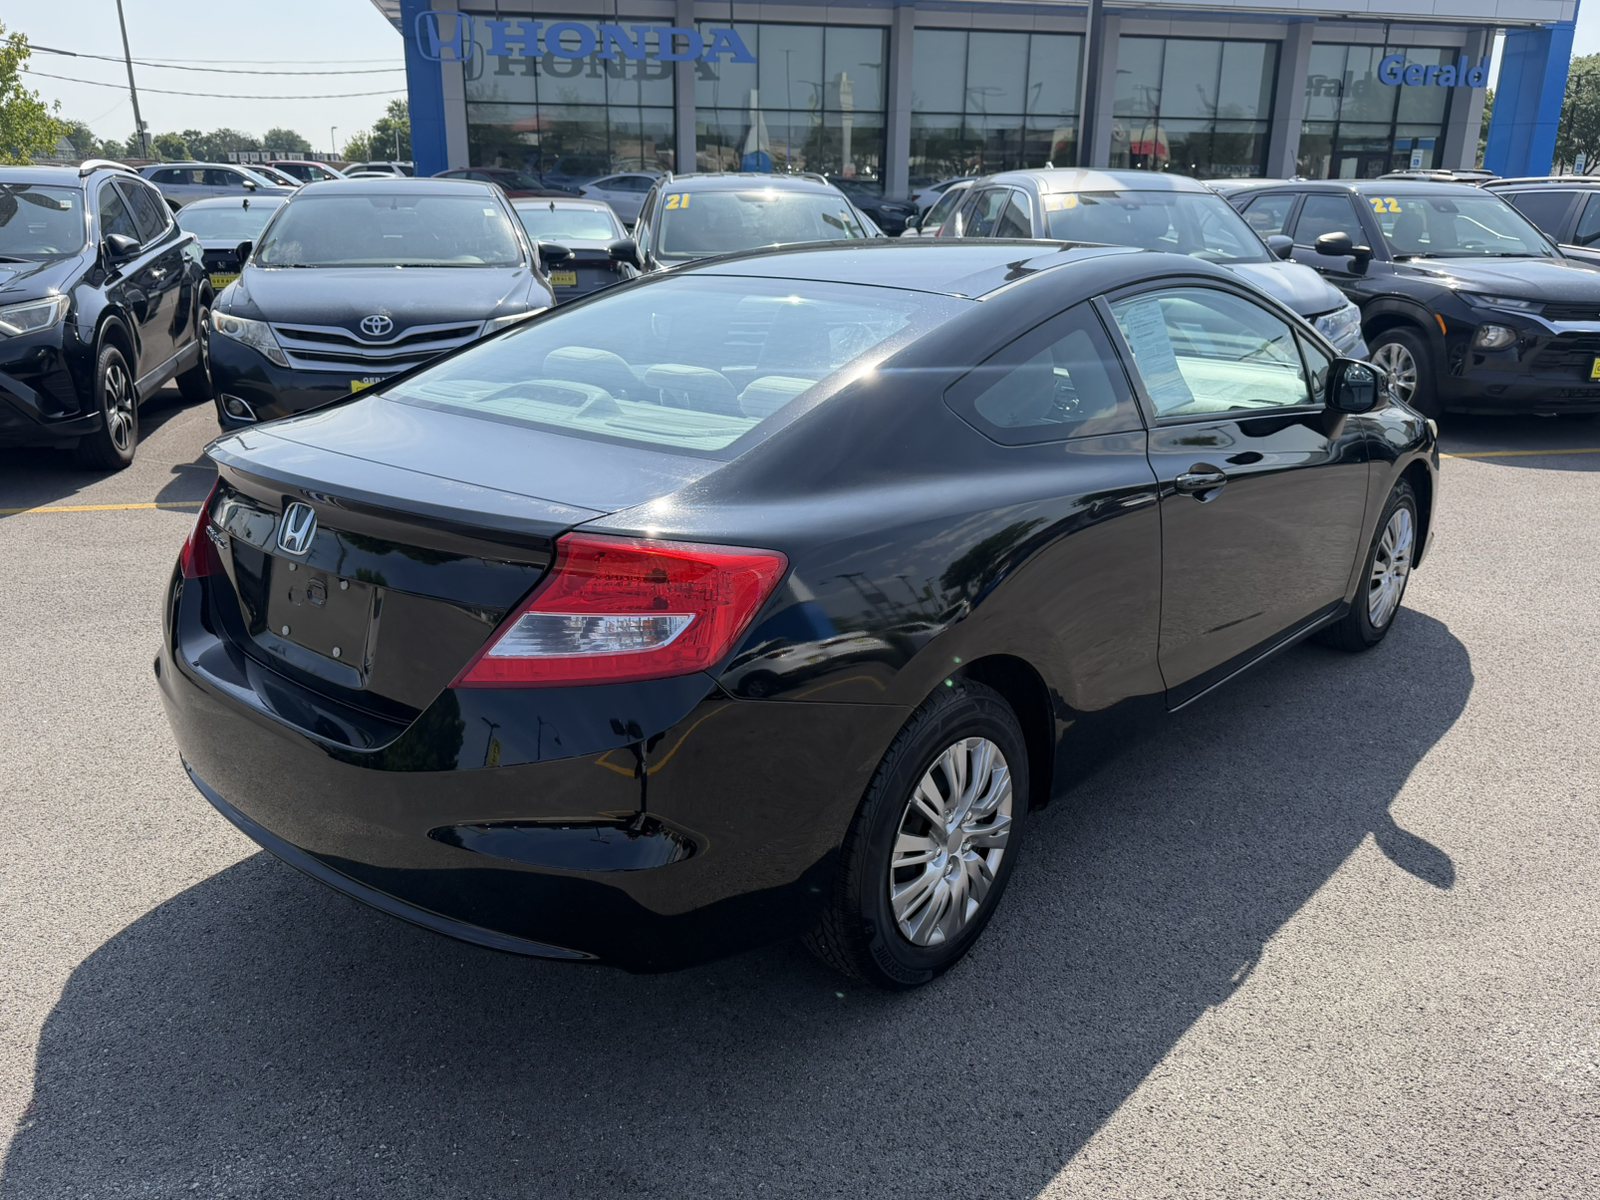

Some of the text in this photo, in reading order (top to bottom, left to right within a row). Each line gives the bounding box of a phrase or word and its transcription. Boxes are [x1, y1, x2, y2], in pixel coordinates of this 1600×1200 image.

[484, 19, 757, 63] HONDA
[1378, 54, 1491, 88] Gerald
[665, 194, 691, 210] 21
[1369, 197, 1403, 214] 22
